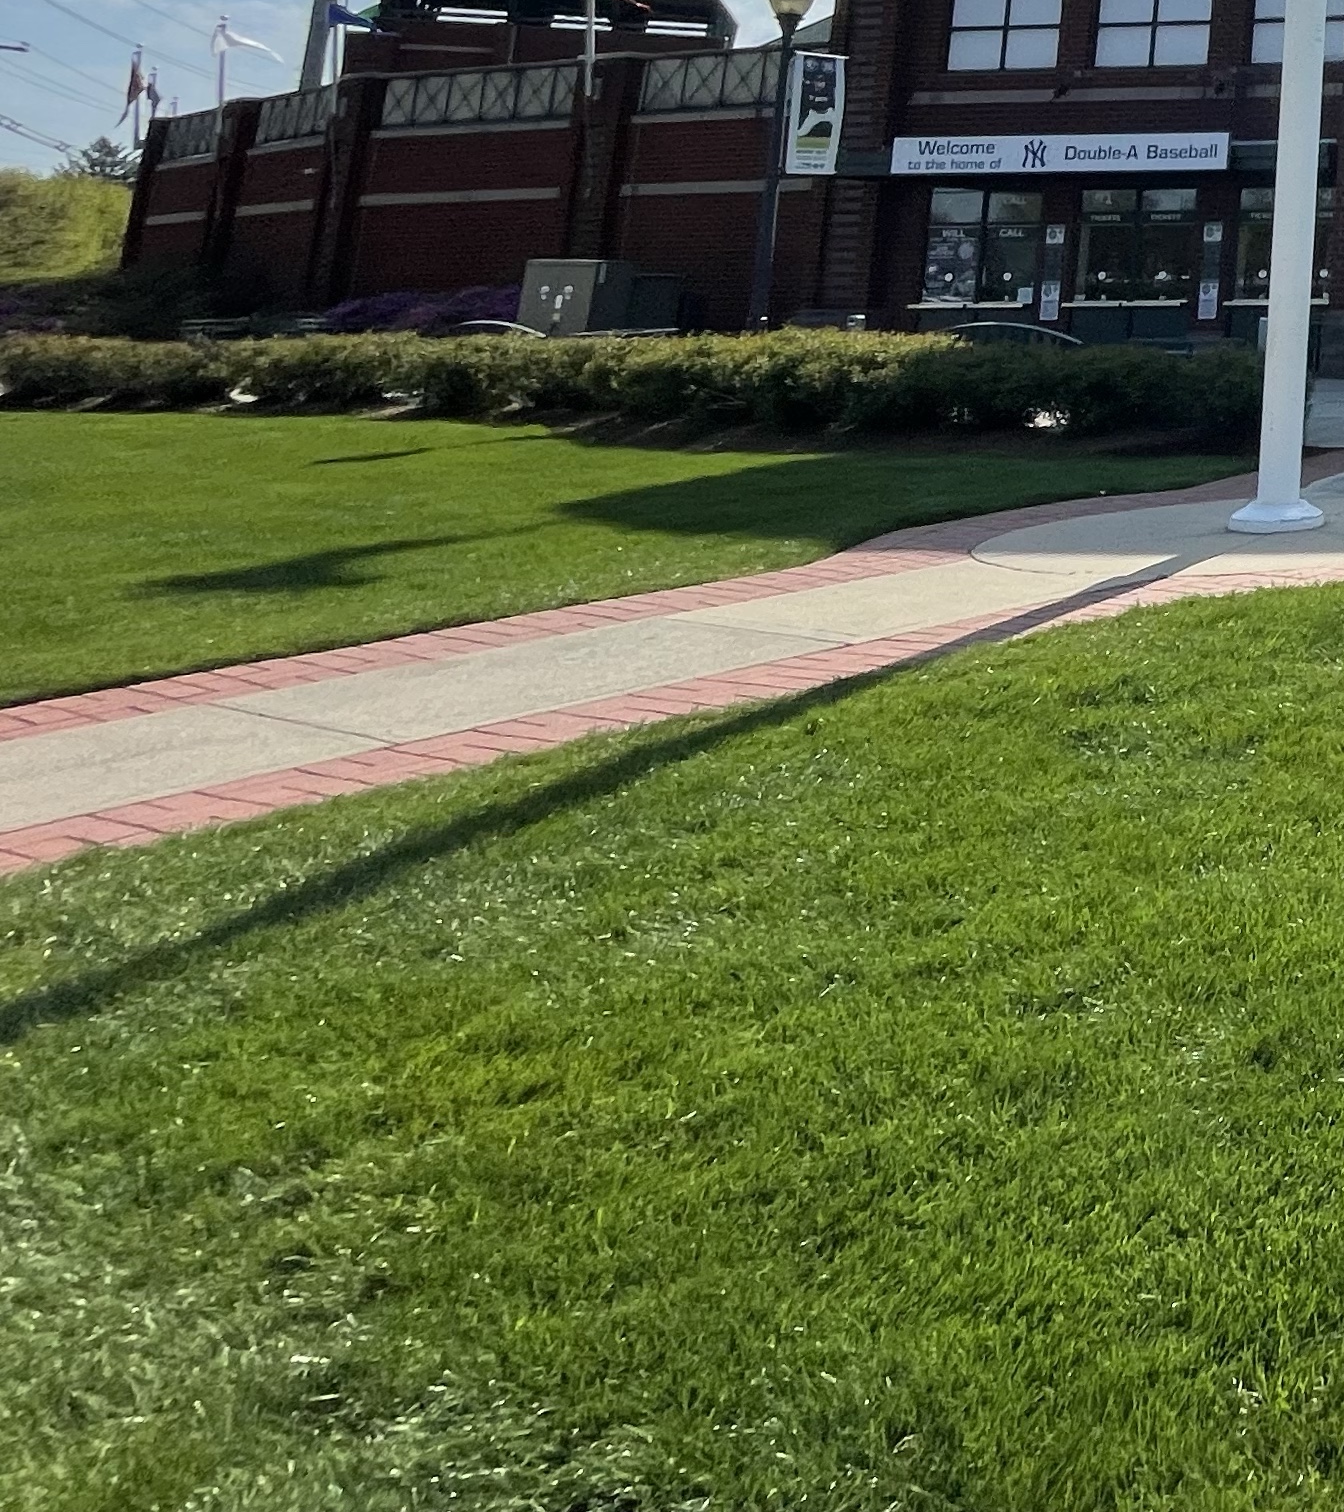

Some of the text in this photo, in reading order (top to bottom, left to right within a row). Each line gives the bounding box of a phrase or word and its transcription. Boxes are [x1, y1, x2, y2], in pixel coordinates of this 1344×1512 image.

[918, 140, 996, 155] Welcome
[1064, 143, 1219, 161] Double-A Baseball
[908, 158, 1003, 171] to the home of
[998, 229, 1024, 238] CALL
